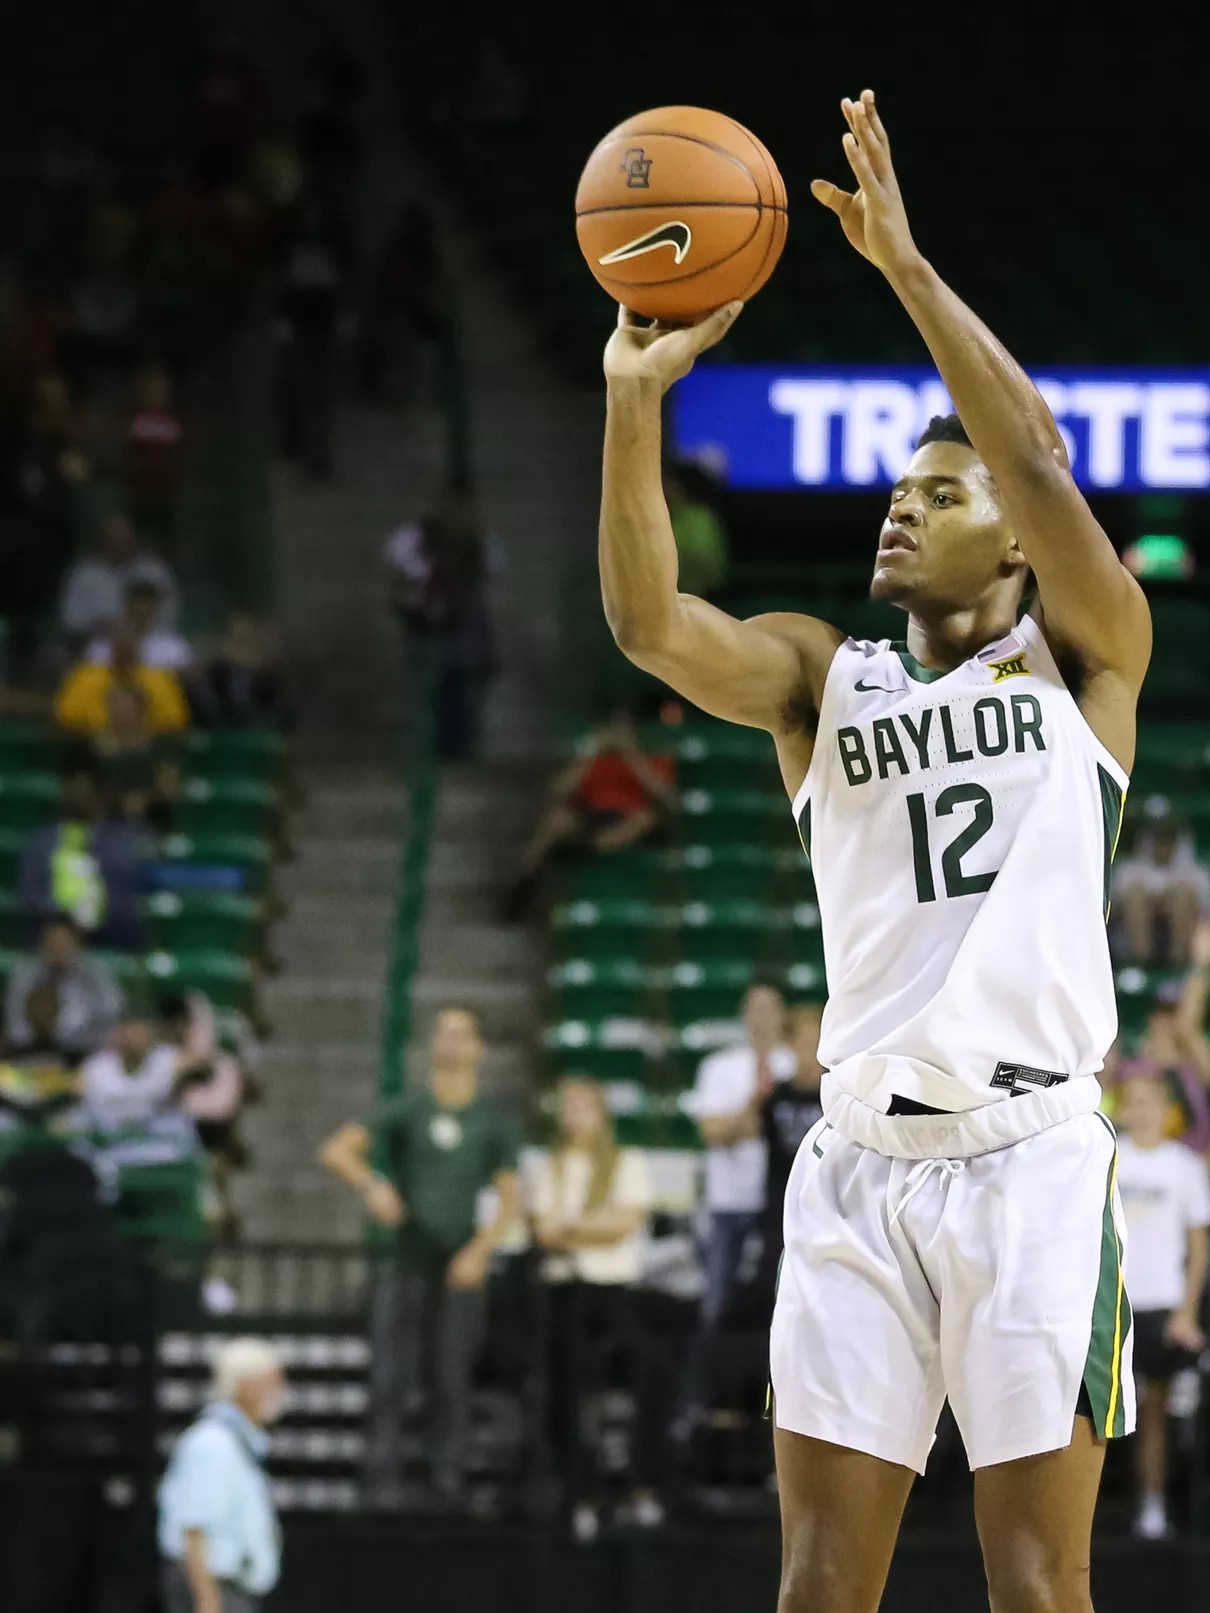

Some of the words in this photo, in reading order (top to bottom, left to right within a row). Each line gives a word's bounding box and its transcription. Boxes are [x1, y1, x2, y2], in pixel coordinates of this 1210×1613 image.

[990, 653, 1029, 681] XII
[838, 694, 1047, 787] BAYLOR
[906, 782, 1000, 903] 12
